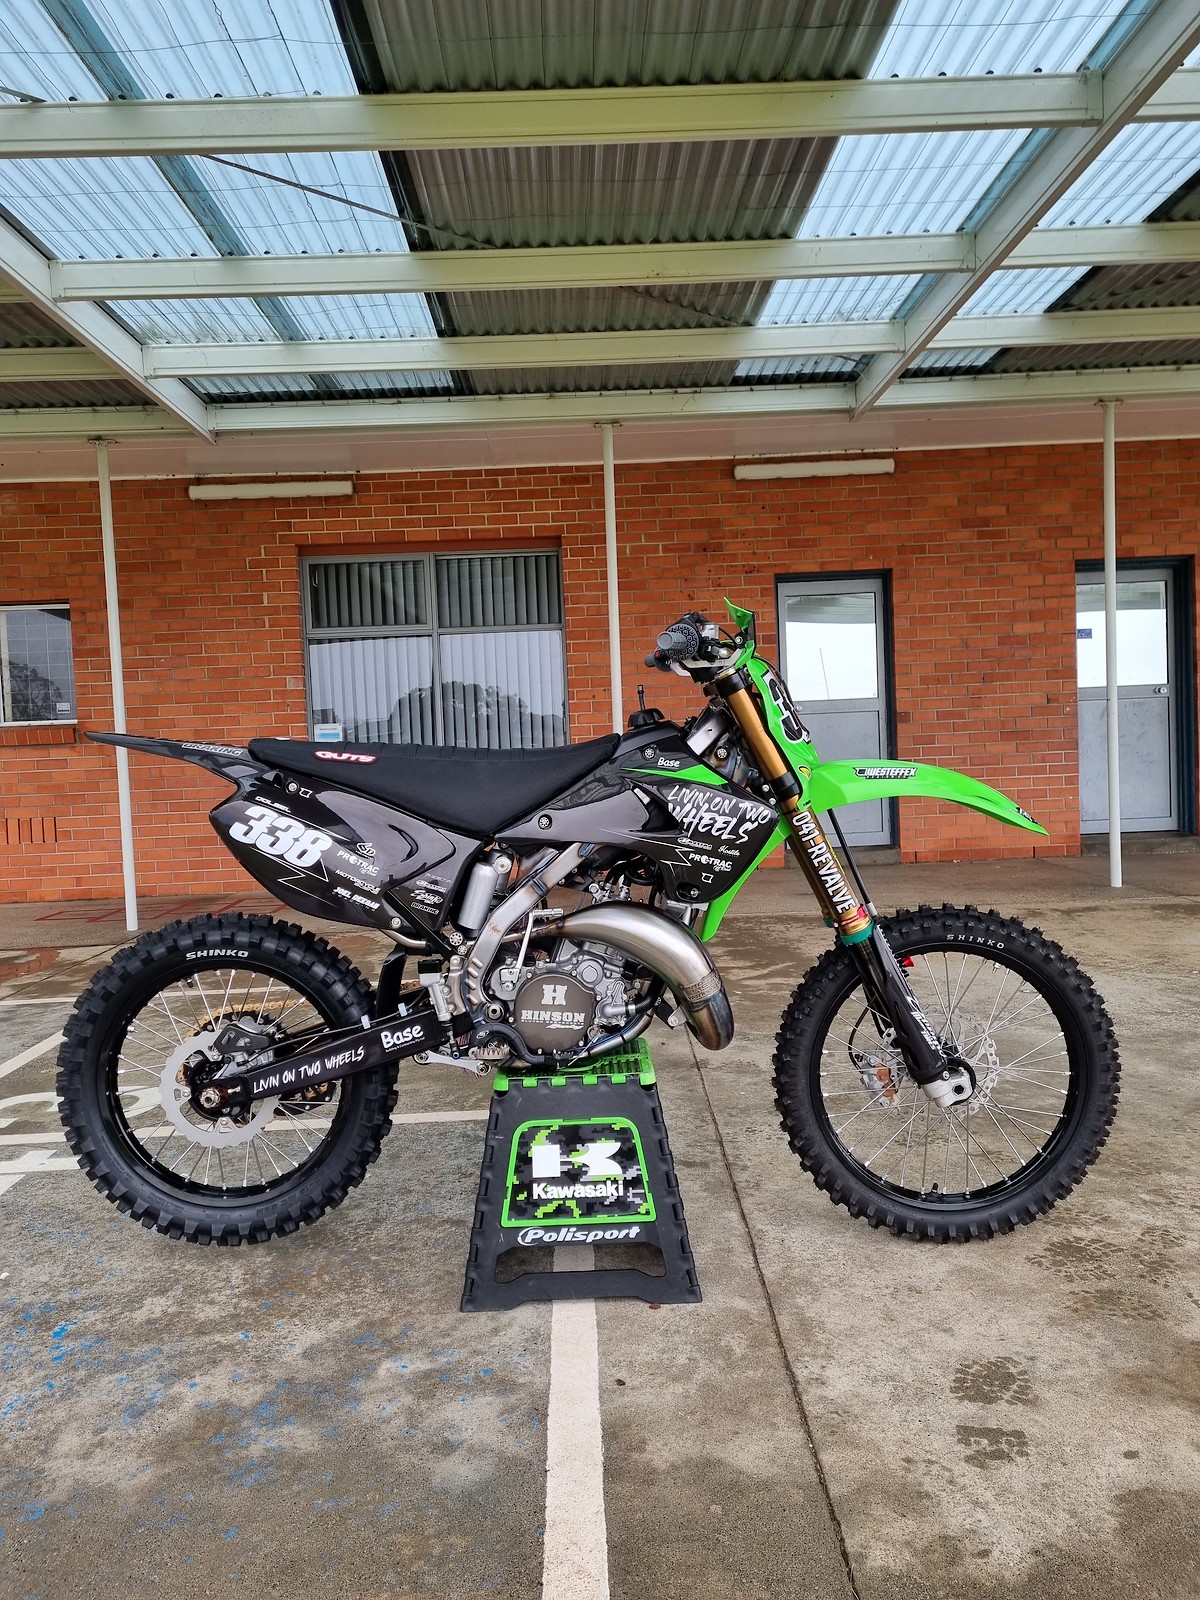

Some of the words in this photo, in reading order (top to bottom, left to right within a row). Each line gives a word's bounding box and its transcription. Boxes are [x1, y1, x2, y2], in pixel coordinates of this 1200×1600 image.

[315, 751, 376, 763] GUTS
[657, 757, 680, 767] Base
[866, 767, 917, 777] WESTEFFEX
[710, 797, 736, 814] ON
[737, 801, 771, 824] TWO
[668, 802, 758, 844] WHEELS
[229, 806, 333, 867] 338
[335, 869, 381, 891] MOTORCYCLE
[946, 933, 1005, 949] SHINKO
[186, 949, 249, 960] SHINKO
[541, 984, 567, 1005] H
[520, 1009, 585, 1022] HINSON
[380, 1025, 424, 1049] Base
[253, 1074, 279, 1094] LIVIN
[282, 1068, 296, 1083] ON
[298, 1060, 321, 1079] TWO
[325, 1045, 365, 1070] WHEELS
[532, 1180, 624, 1200] Kawasaki
[521, 1226, 641, 1244] Polisport
